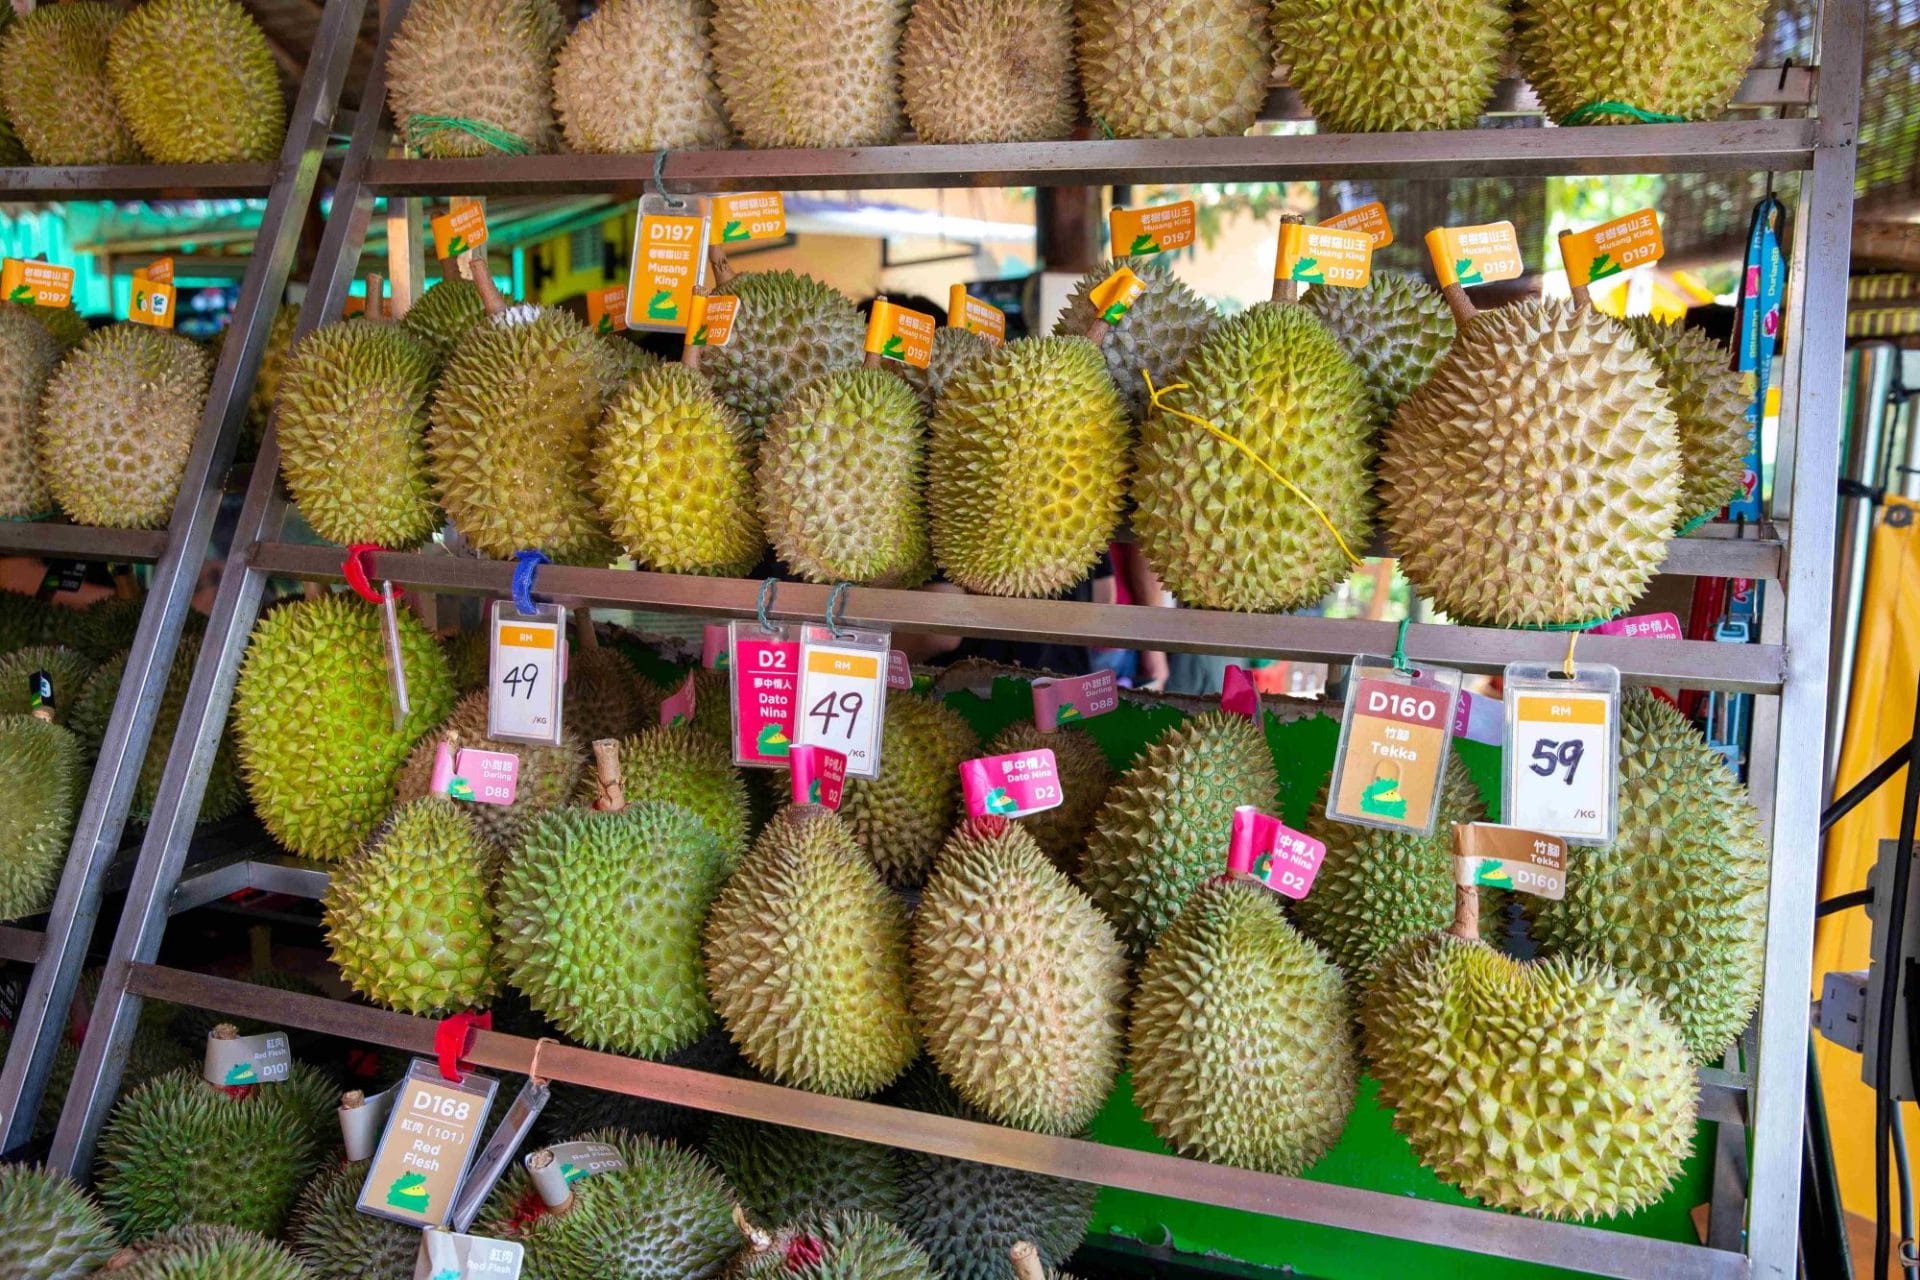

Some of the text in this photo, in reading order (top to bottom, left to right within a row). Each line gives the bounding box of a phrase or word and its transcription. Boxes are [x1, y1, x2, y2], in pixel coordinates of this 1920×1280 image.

[1140, 207, 1191, 224] 老樹貓山王
[752, 221, 781, 233] D197
[1143, 218, 1191, 232] Musang King
[1594, 215, 1652, 244] 老樹貓山王
[650, 224, 694, 241] D197
[1163, 231, 1191, 245] D197
[1457, 231, 1511, 246] 老樹貓山王
[1599, 228, 1654, 251] Musang King
[1309, 247, 1343, 260] Musang
[1462, 243, 1492, 255] Musang
[1622, 243, 1657, 263] D197
[648, 262, 687, 276] Musang
[1328, 266, 1364, 280] D197
[1483, 260, 1515, 274] D197
[654, 275, 678, 287] King
[38, 290, 66, 302] D197
[907, 345, 928, 362] D197
[1625, 619, 1674, 637] 夢中情人
[520, 633, 534, 642] RM
[759, 650, 786, 668] D2
[835, 660, 851, 671] RM
[503, 663, 538, 700] 49
[753, 677, 792, 690] 夢中情人
[1085, 685, 1112, 697] Darling
[759, 693, 788, 704] Dato
[1090, 697, 1114, 711] D88
[1369, 691, 1436, 720] D160
[760, 707, 787, 718] Nina
[809, 691, 863, 740] 49
[1551, 706, 1572, 716] RM
[532, 716, 547, 725] /KG
[848, 749, 866, 758] /KG
[1371, 742, 1417, 761] Tekka
[1002, 757, 1051, 775] 夢中情人
[1529, 738, 1584, 785] 59
[484, 770, 512, 781] Darling
[1007, 769, 1052, 783] Dato Nina
[485, 785, 510, 798] D88
[828, 789, 838, 803] D2
[1035, 786, 1055, 800] D2
[1574, 809, 1596, 819] /KG
[1279, 832, 1315, 861] 中情人
[1290, 854, 1312, 870] Nina
[1530, 854, 1560, 868] Tekka
[1282, 871, 1305, 891] D2
[1518, 870, 1558, 890] D160
[268, 1049, 286, 1058] Flesh
[263, 1062, 288, 1076] D101
[413, 1091, 470, 1121] D168
[412, 1140, 441, 1156] Red
[402, 1152, 440, 1172] Flesh
[571, 1153, 590, 1161] Red
[588, 1160, 622, 1170] D101
[467, 1260, 511, 1273] Red Flesh
